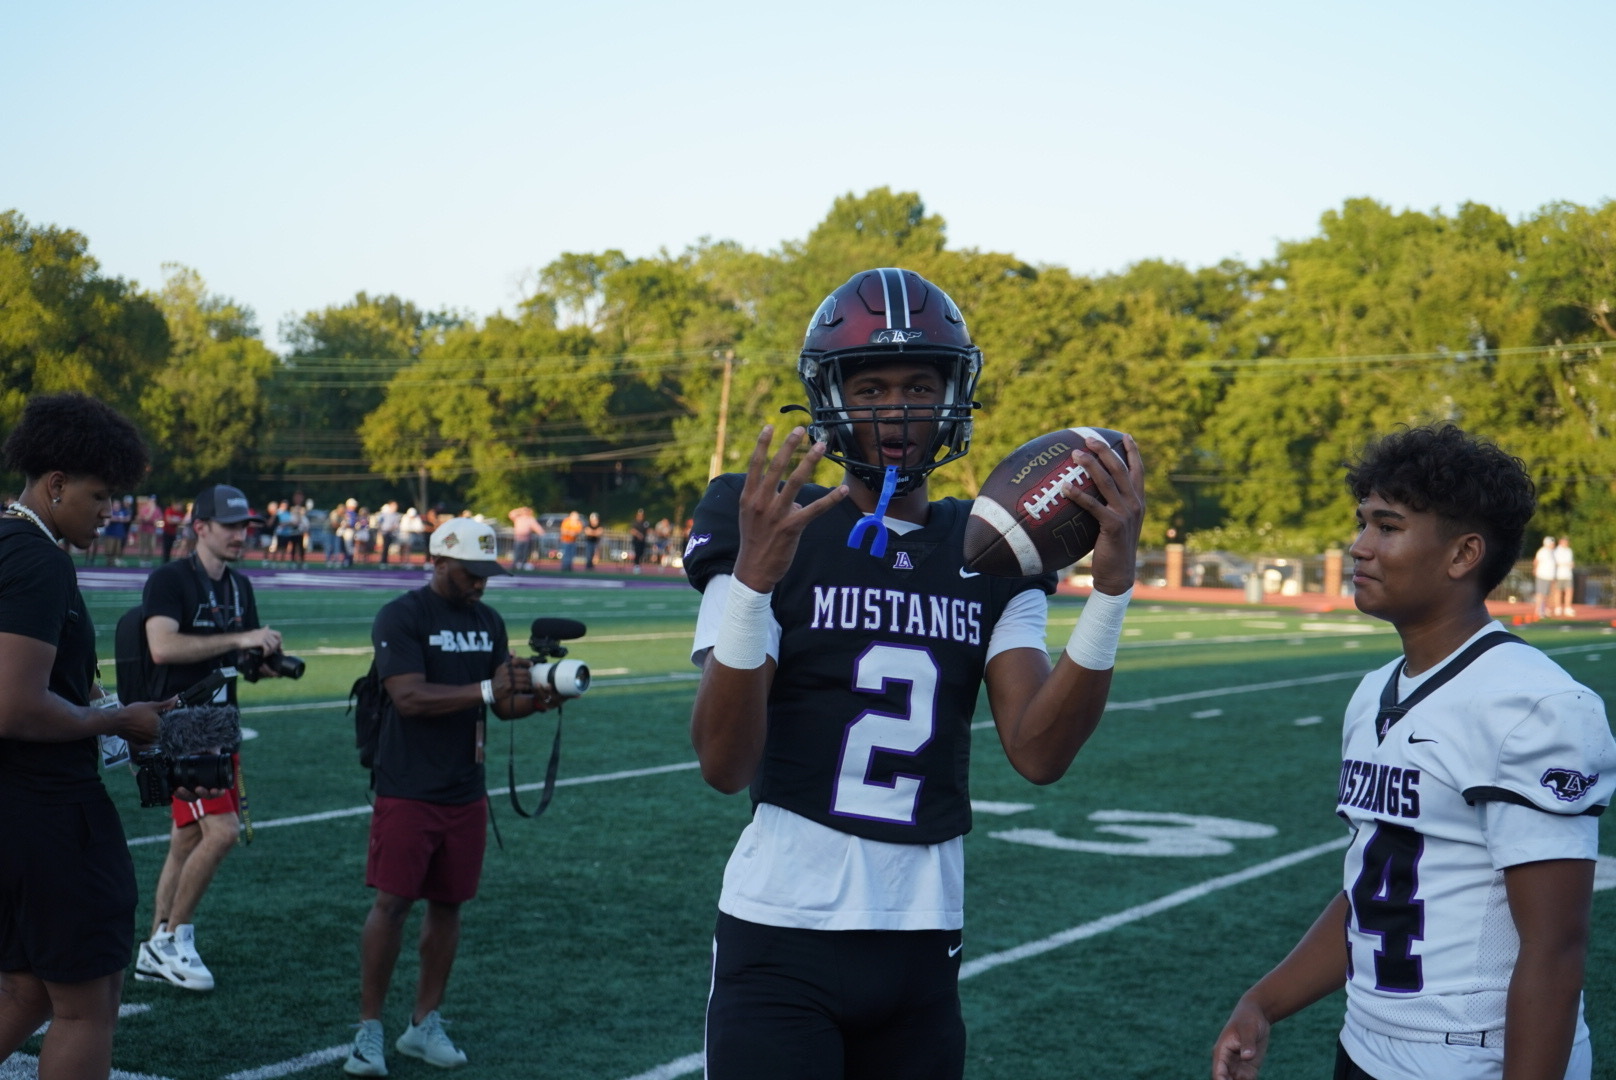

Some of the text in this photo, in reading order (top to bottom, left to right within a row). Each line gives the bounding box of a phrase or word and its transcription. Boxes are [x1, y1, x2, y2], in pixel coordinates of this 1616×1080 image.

[1011, 442, 1071, 485] Wilson
[893, 551, 914, 569] LA
[440, 630, 494, 652] BALL
[810, 585, 982, 646] MUSTANGS
[829, 640, 941, 825] 2
[1338, 759, 1421, 819] USTANGS
[1562, 774, 1583, 792] LA
[1345, 817, 1425, 993] 4
